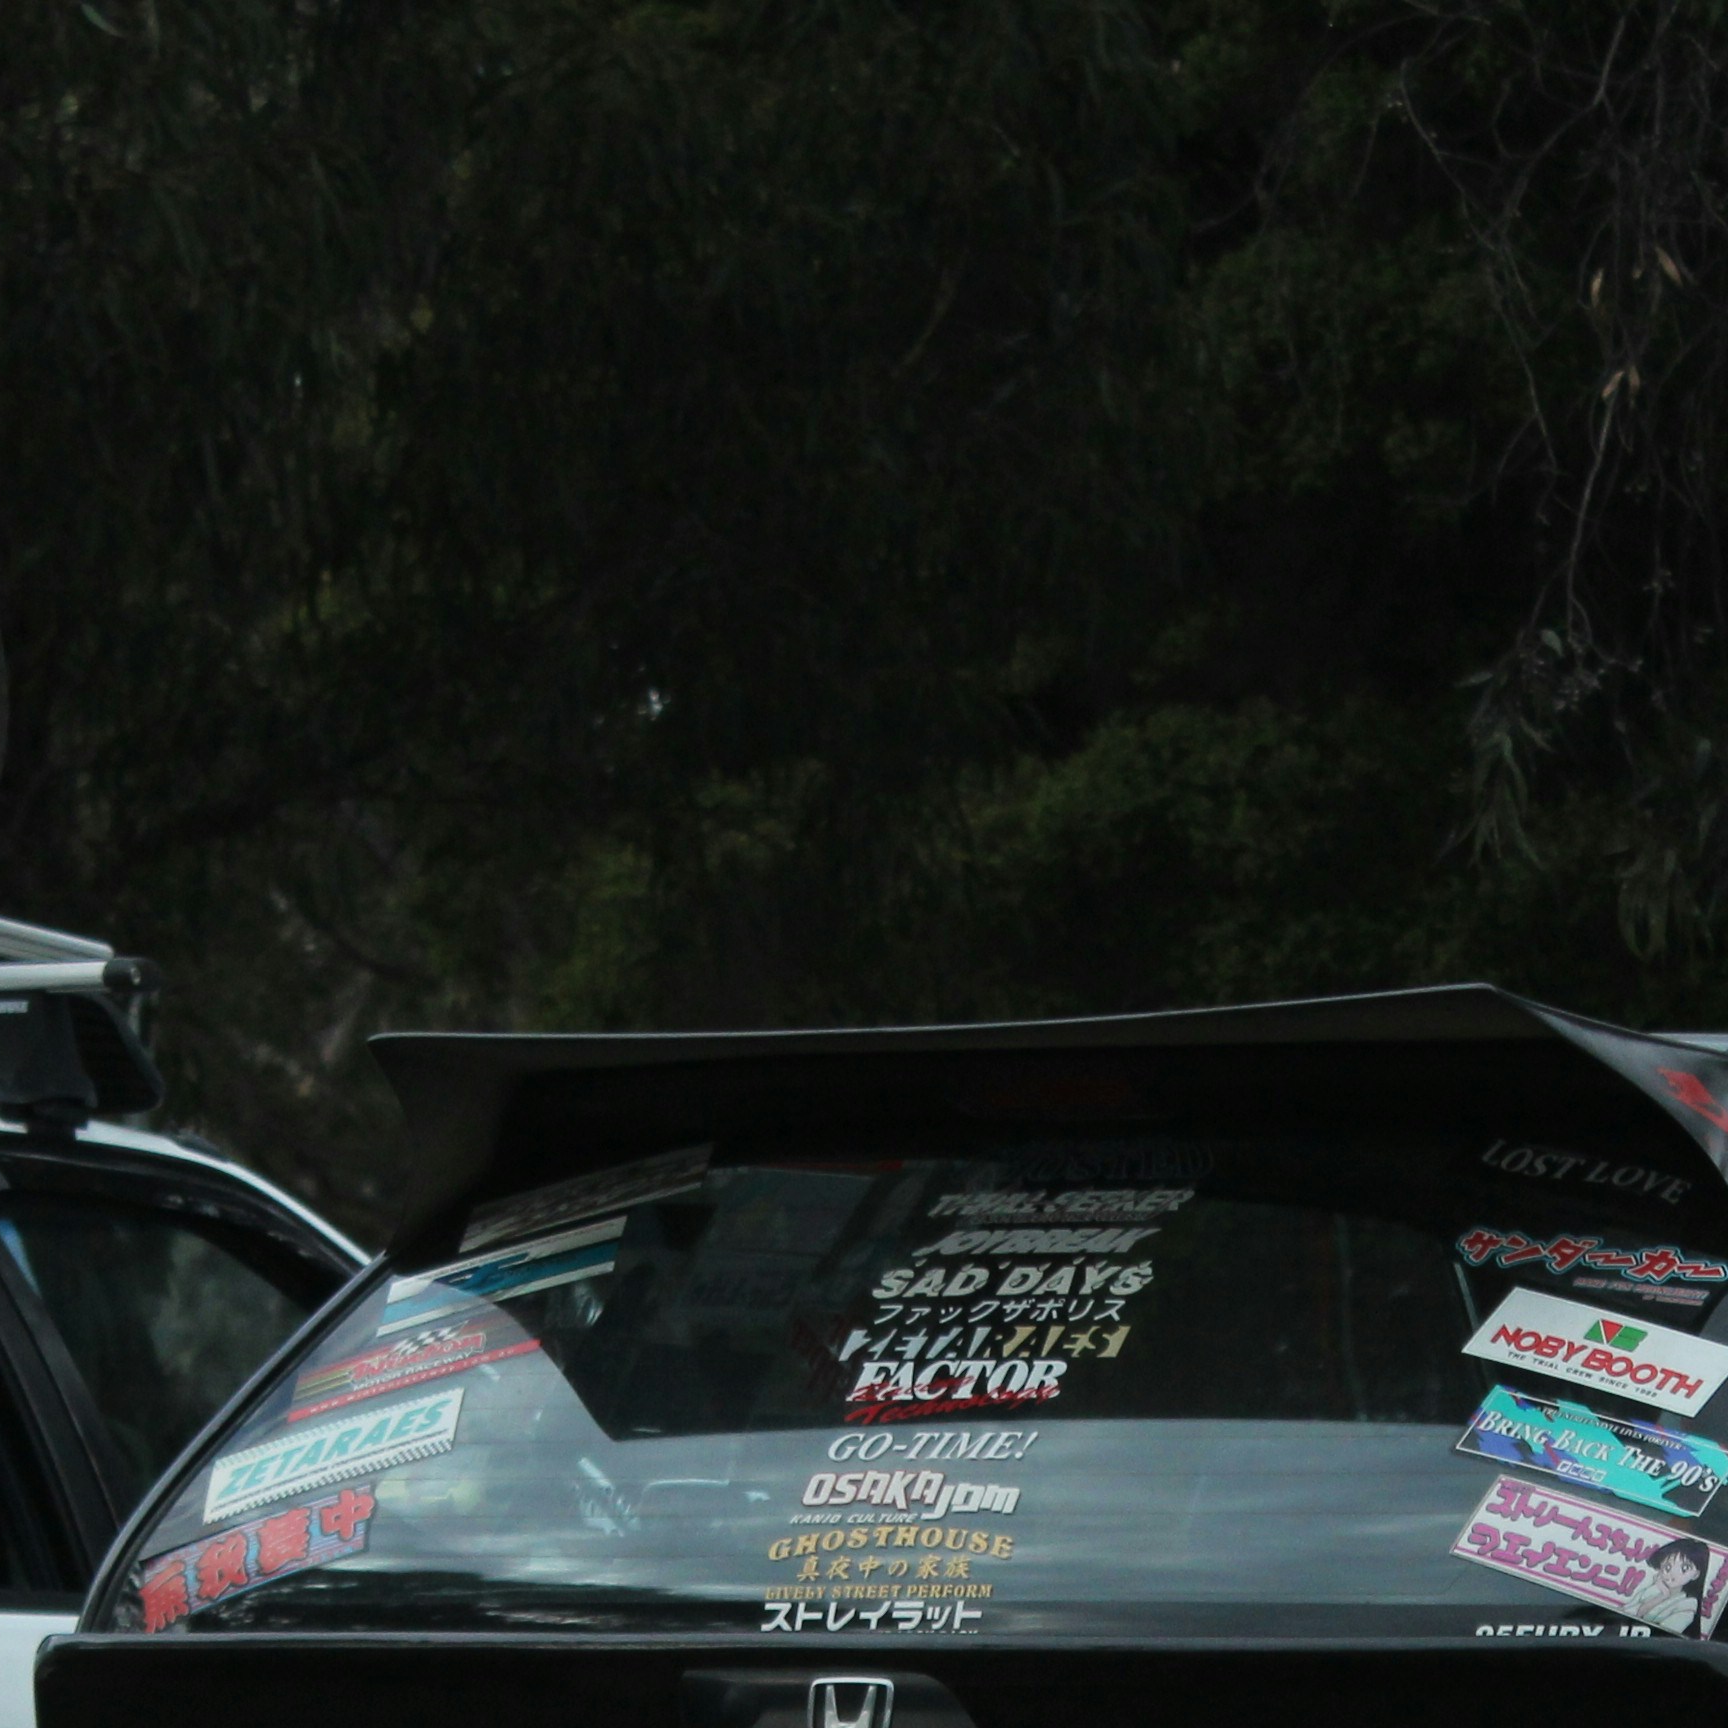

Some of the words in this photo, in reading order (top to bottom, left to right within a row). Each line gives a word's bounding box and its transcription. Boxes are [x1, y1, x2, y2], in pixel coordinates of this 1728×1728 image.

[1480, 1137, 1586, 1180] LOST
[1583, 1160, 1694, 1205] LOVE
[872, 1262, 990, 1299] SAD
[995, 1257, 1155, 1297] DAYS
[845, 1359, 1069, 1402] FACTOR
[1490, 1324, 1588, 1363] NOBY
[1581, 1347, 1704, 1399] BOOTH
[217, 1399, 449, 1506] ZETARAES
[827, 1431, 1039, 1461] GO-TIME!
[846, 1512, 918, 1525] CULTURE
[768, 1525, 1015, 1561] GHOSTHOUSE
[831, 1584, 902, 1600] STREET
[906, 1583, 994, 1599] PERFORM
[761, 1600, 984, 1633] ストレイラット
